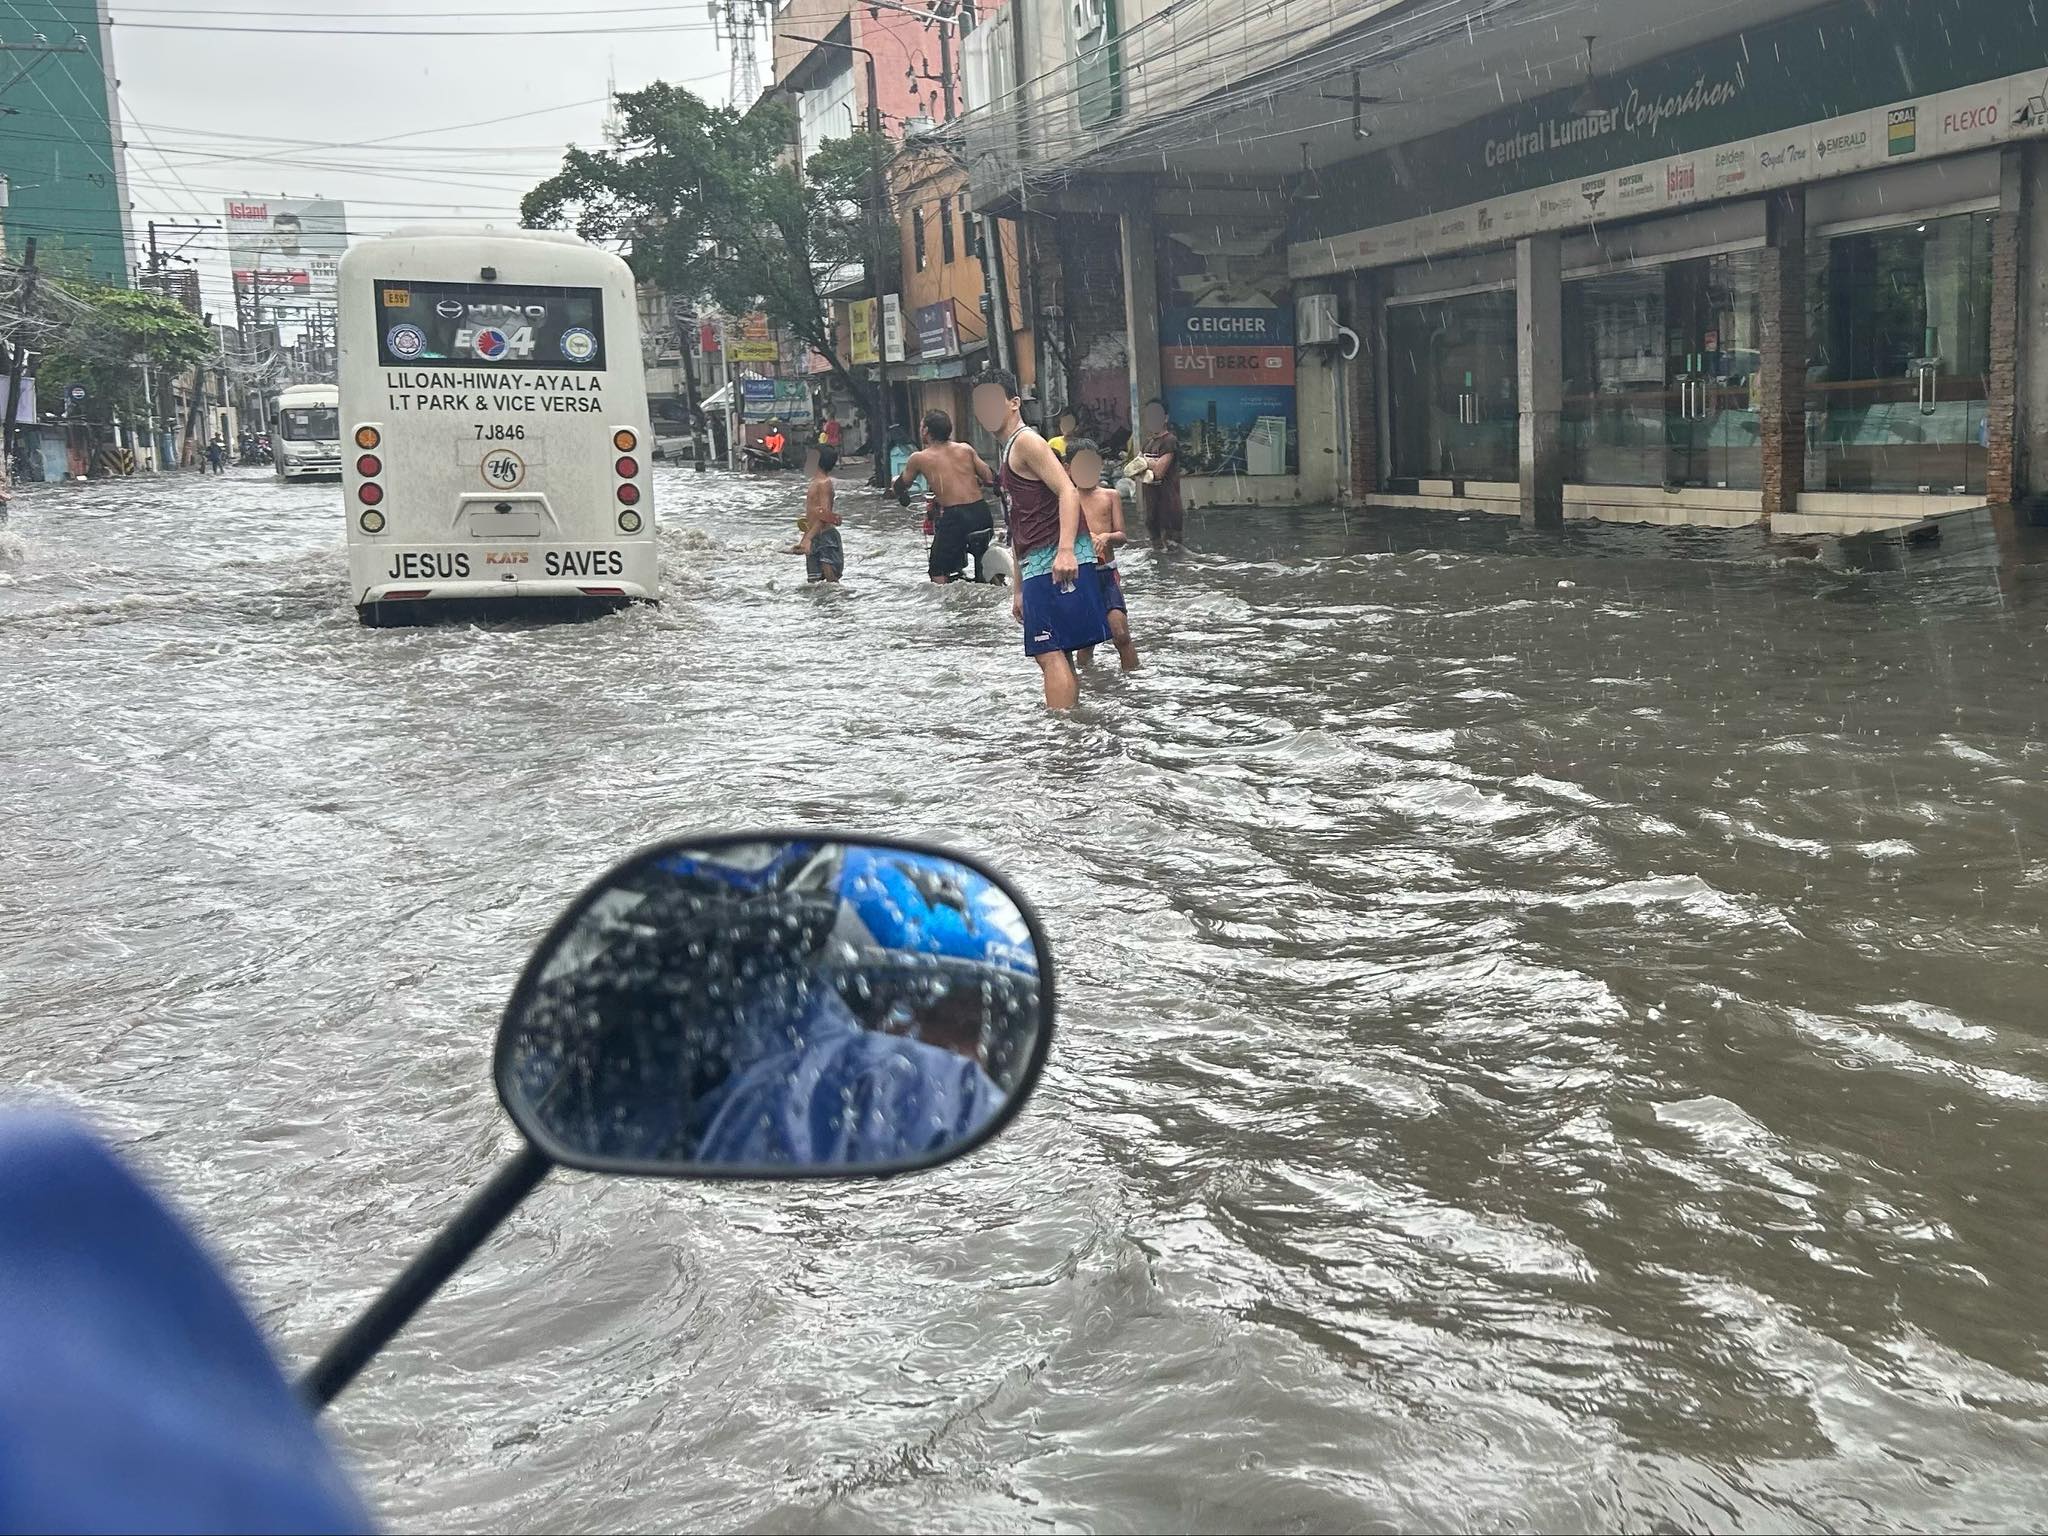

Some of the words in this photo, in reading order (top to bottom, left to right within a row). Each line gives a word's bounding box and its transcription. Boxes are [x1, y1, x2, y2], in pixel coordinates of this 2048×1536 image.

[1485, 122, 1544, 168] Central
[1550, 107, 1623, 149] Lumber
[1624, 77, 1736, 138] Corporation
[1888, 106, 1915, 126] BORAL
[1944, 105, 1998, 135] FLEXCO
[1826, 131, 1868, 152] EMERALD
[1619, 173, 1644, 188] BOYSEN
[1667, 162, 1695, 200] Island
[229, 202, 268, 220] Island
[468, 303, 546, 318] HINO
[1186, 316, 1267, 333] GEIGHER
[1174, 355, 1260, 379] EASTBERG
[387, 372, 602, 392] LILOAN-HIWAY-AYALA
[389, 394, 411, 411] I.T
[417, 394, 470, 411] PARK
[475, 395, 489, 411] &
[493, 395, 536, 412] VICE
[540, 396, 602, 413] VERSA
[474, 424, 526, 441] 7J846
[388, 552, 471, 579] JESUS
[545, 550, 624, 577] SAVES
